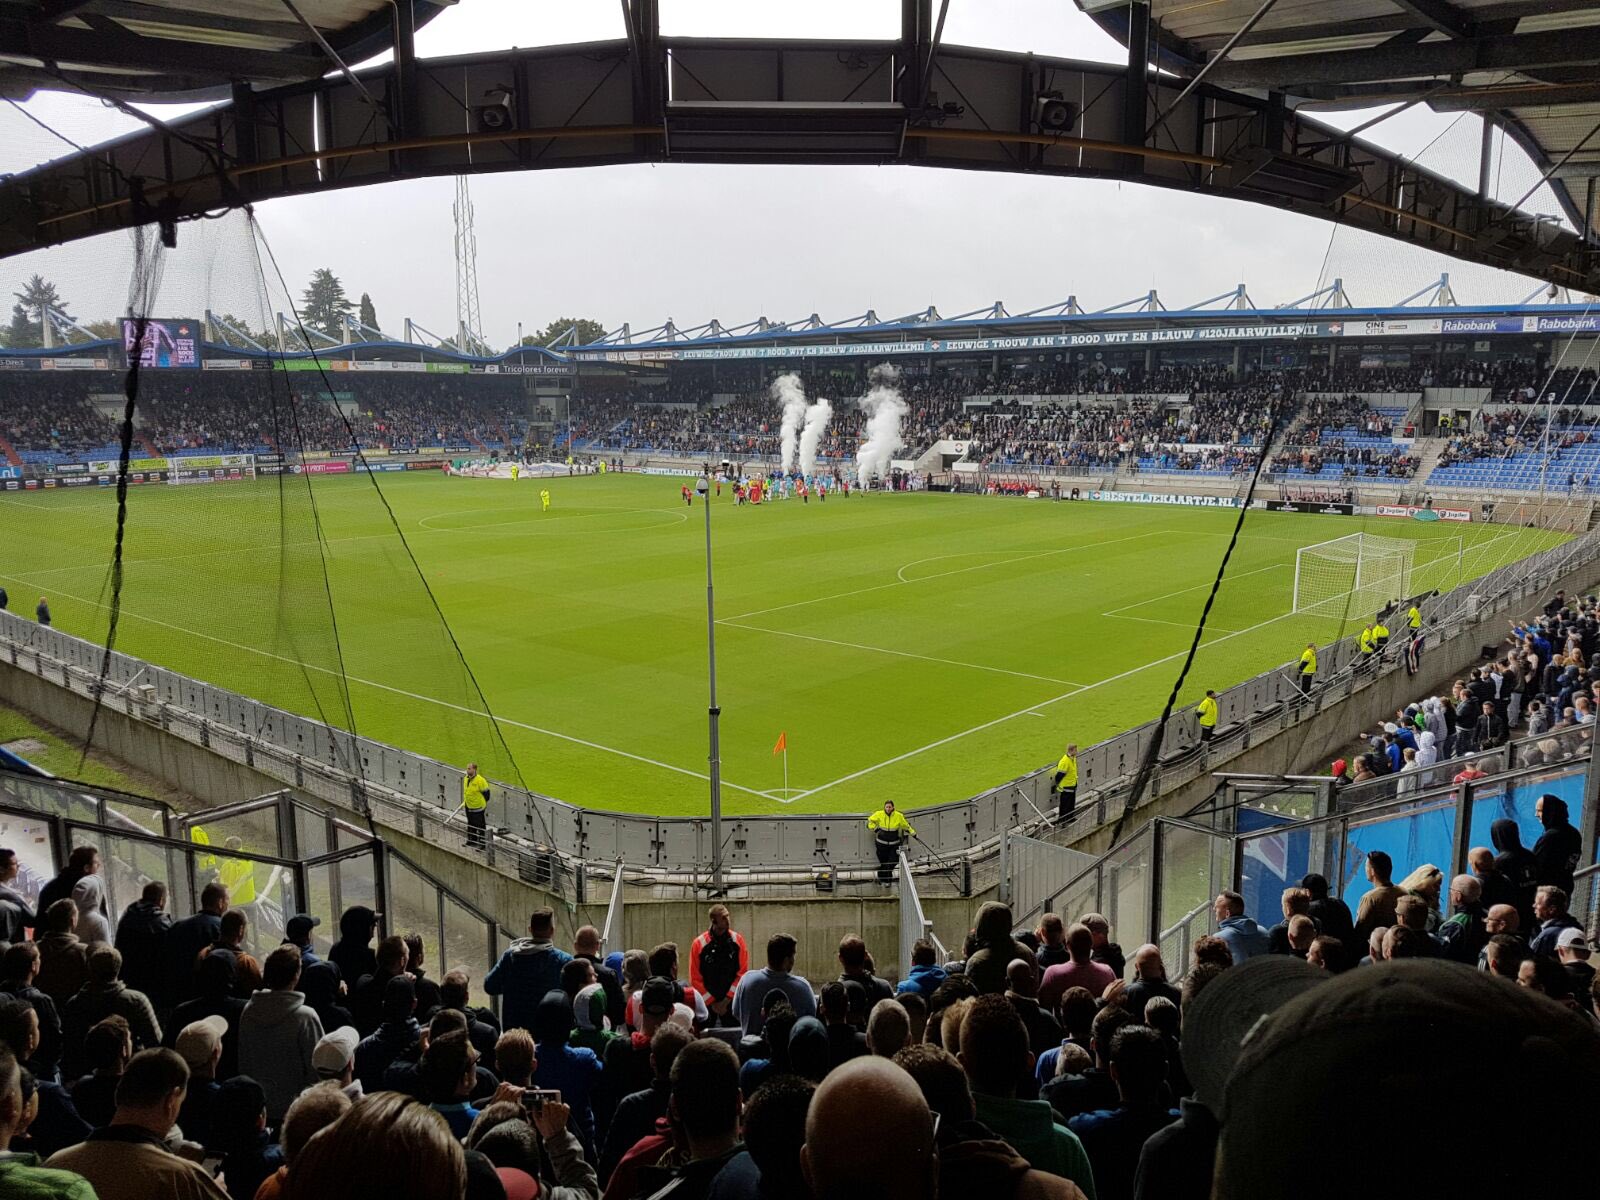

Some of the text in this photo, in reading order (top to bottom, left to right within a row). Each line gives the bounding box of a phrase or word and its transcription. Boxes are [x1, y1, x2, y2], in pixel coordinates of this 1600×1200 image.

[1365, 321, 1385, 329] CINE
[1443, 320, 1497, 331] Rabobank
[1539, 315, 1596, 329] Rabobank
[946, 340, 989, 350] EEUWIGE
[992, 338, 1029, 348] TROUW
[1032, 337, 1054, 346] AAN
[1071, 334, 1100, 344] ROOD
[1104, 332, 1129, 343] WIT
[1132, 331, 1148, 341] EN
[1151, 329, 1195, 341] BLAUW
[767, 348, 787, 356] ROOD
[819, 346, 847, 355] BLAUW
[503, 365, 541, 374] Tricolores
[1103, 490, 1235, 507] BESTELJEKAARTJE.NL
